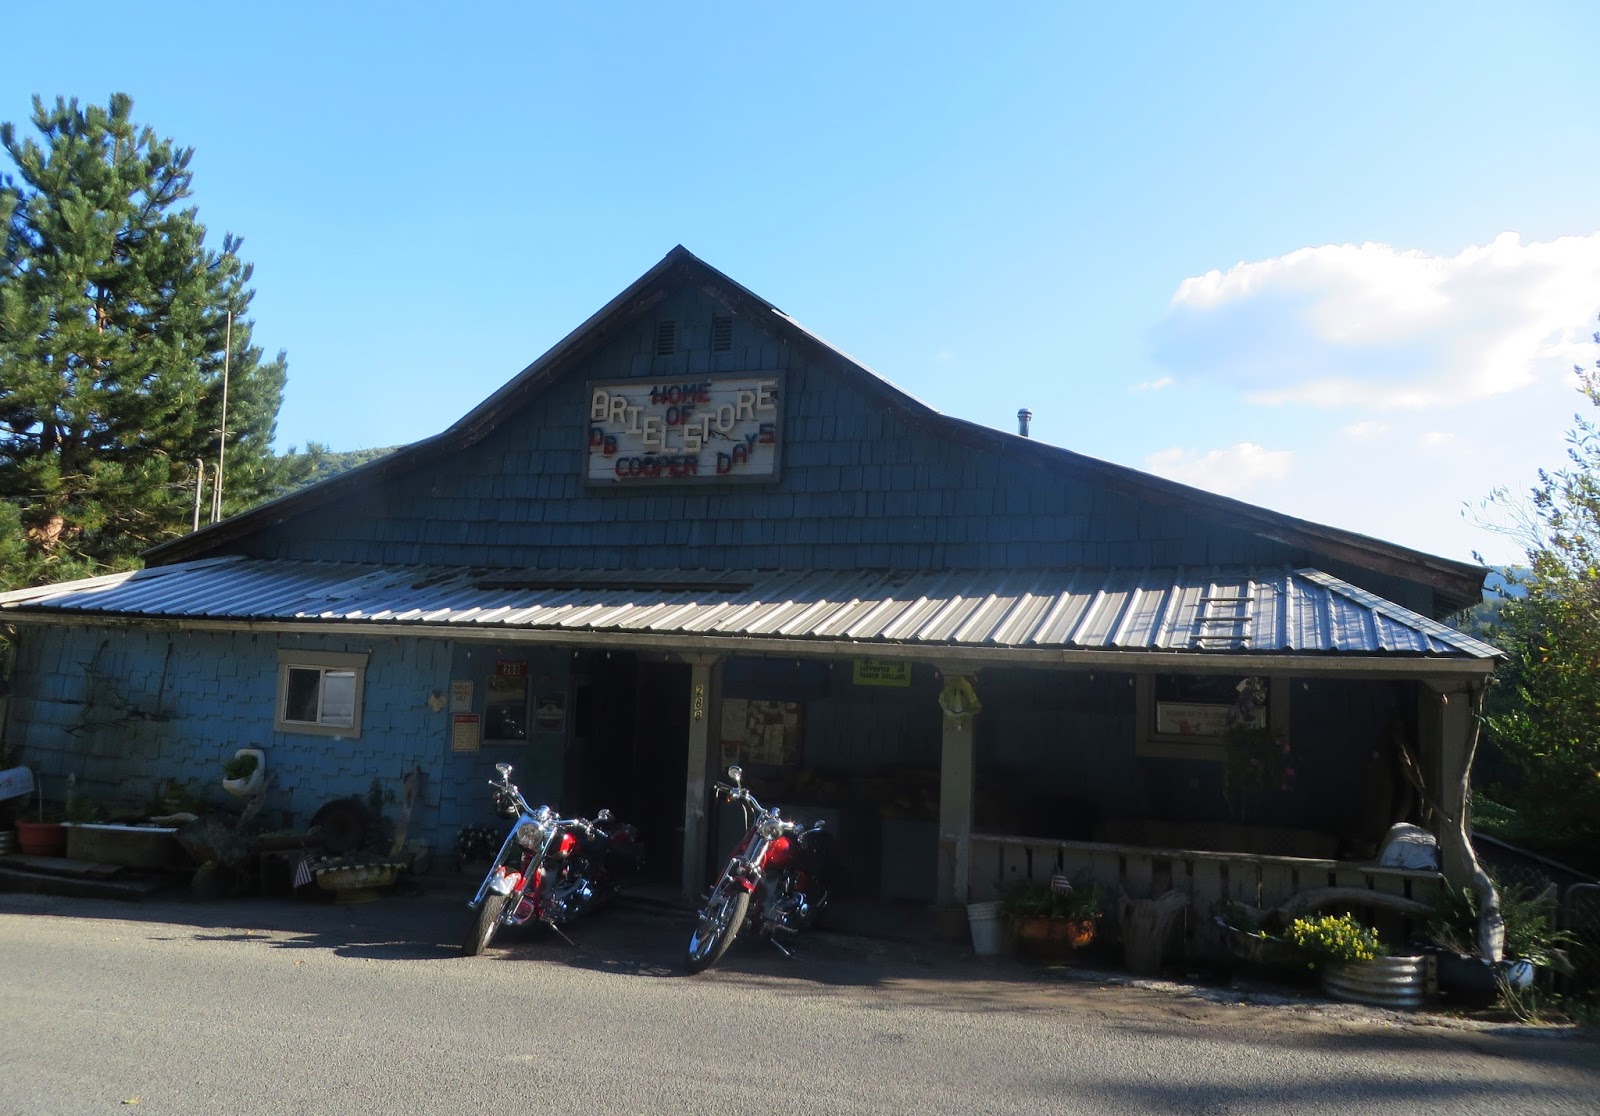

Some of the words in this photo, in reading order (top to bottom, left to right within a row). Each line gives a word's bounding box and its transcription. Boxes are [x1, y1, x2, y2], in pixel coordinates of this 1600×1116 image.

[651, 383, 711, 405] HOME
[591, 389, 679, 453] ARIEL
[684, 380, 778, 452] STORE
[666, 405, 695, 426] OF
[615, 456, 699, 477] COOPER
[716, 423, 776, 474] DAYS
[695, 685, 703, 721] 288
